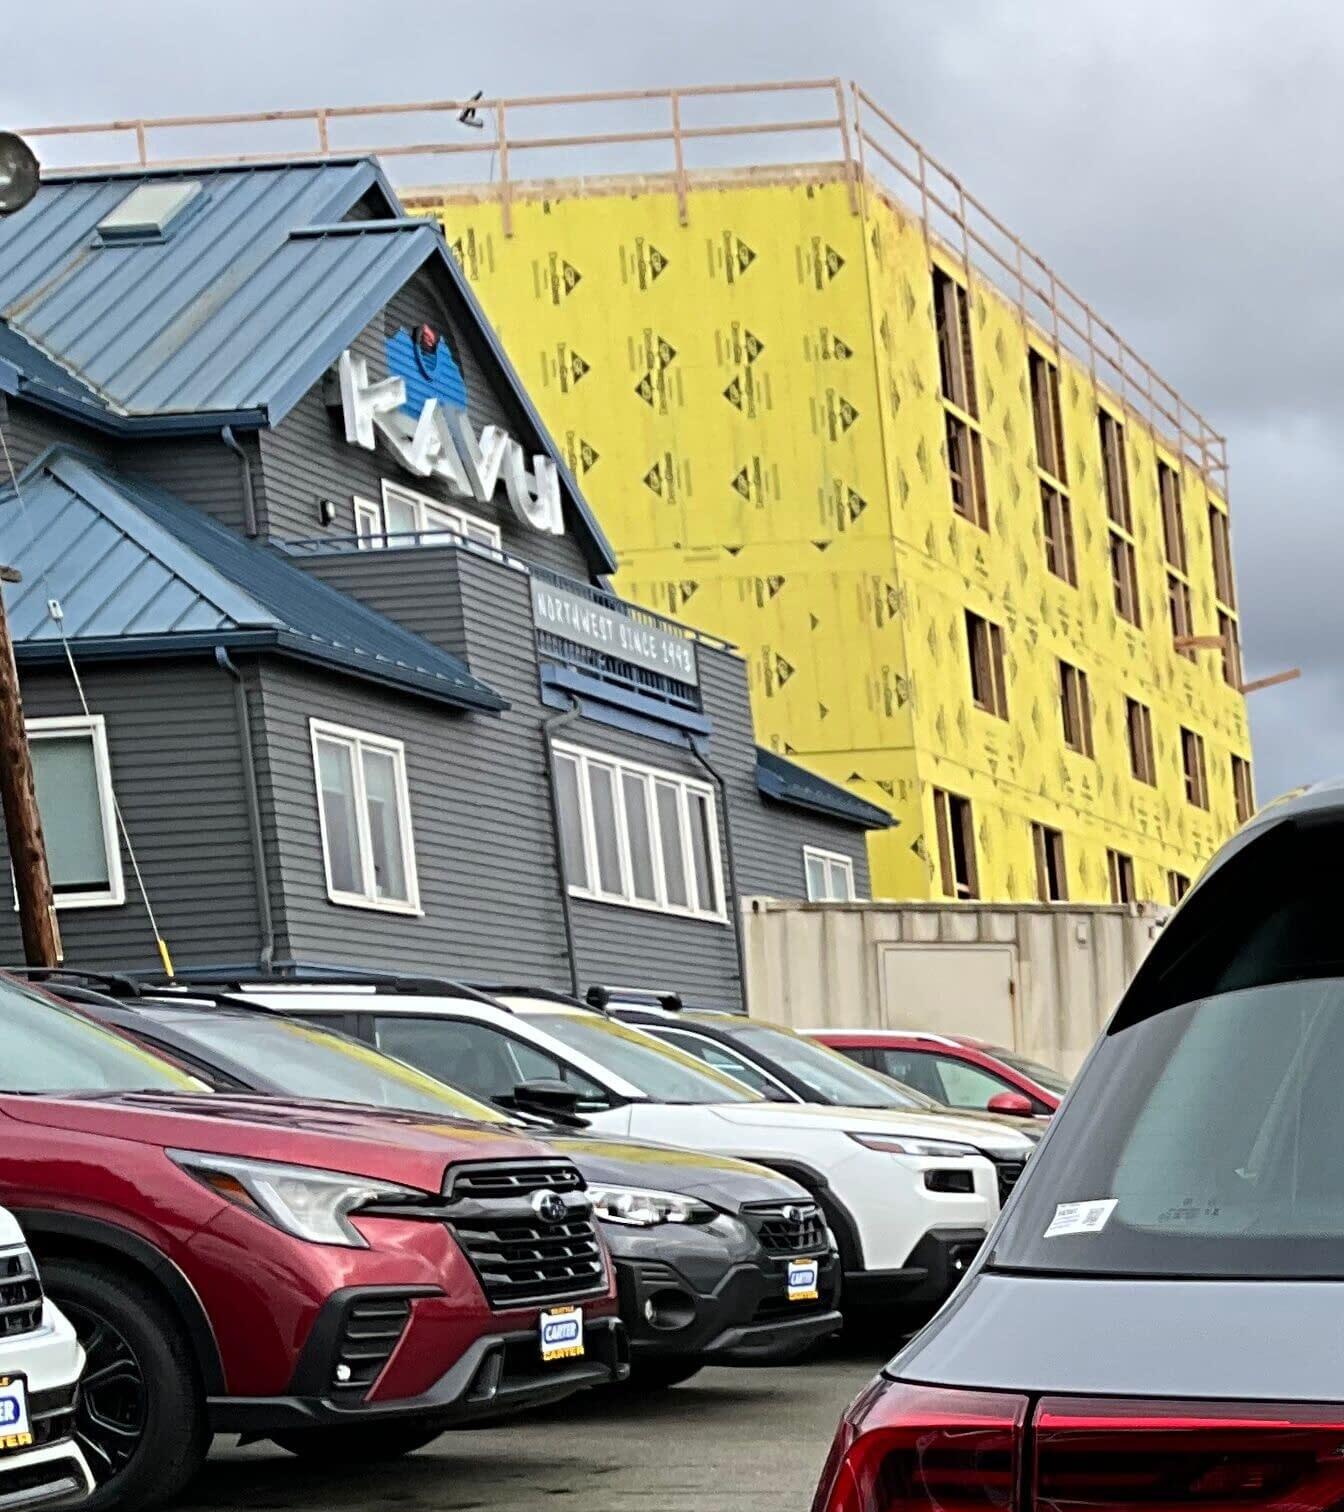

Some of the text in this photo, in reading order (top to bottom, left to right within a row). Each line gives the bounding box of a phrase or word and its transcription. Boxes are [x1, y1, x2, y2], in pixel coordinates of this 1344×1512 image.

[338, 350, 565, 535] KAVU
[537, 592, 614, 641] NORTHWEST
[619, 623, 657, 659] SINCE
[543, 1345, 584, 1361] CARTER
[545, 1322, 577, 1342] CARTER
